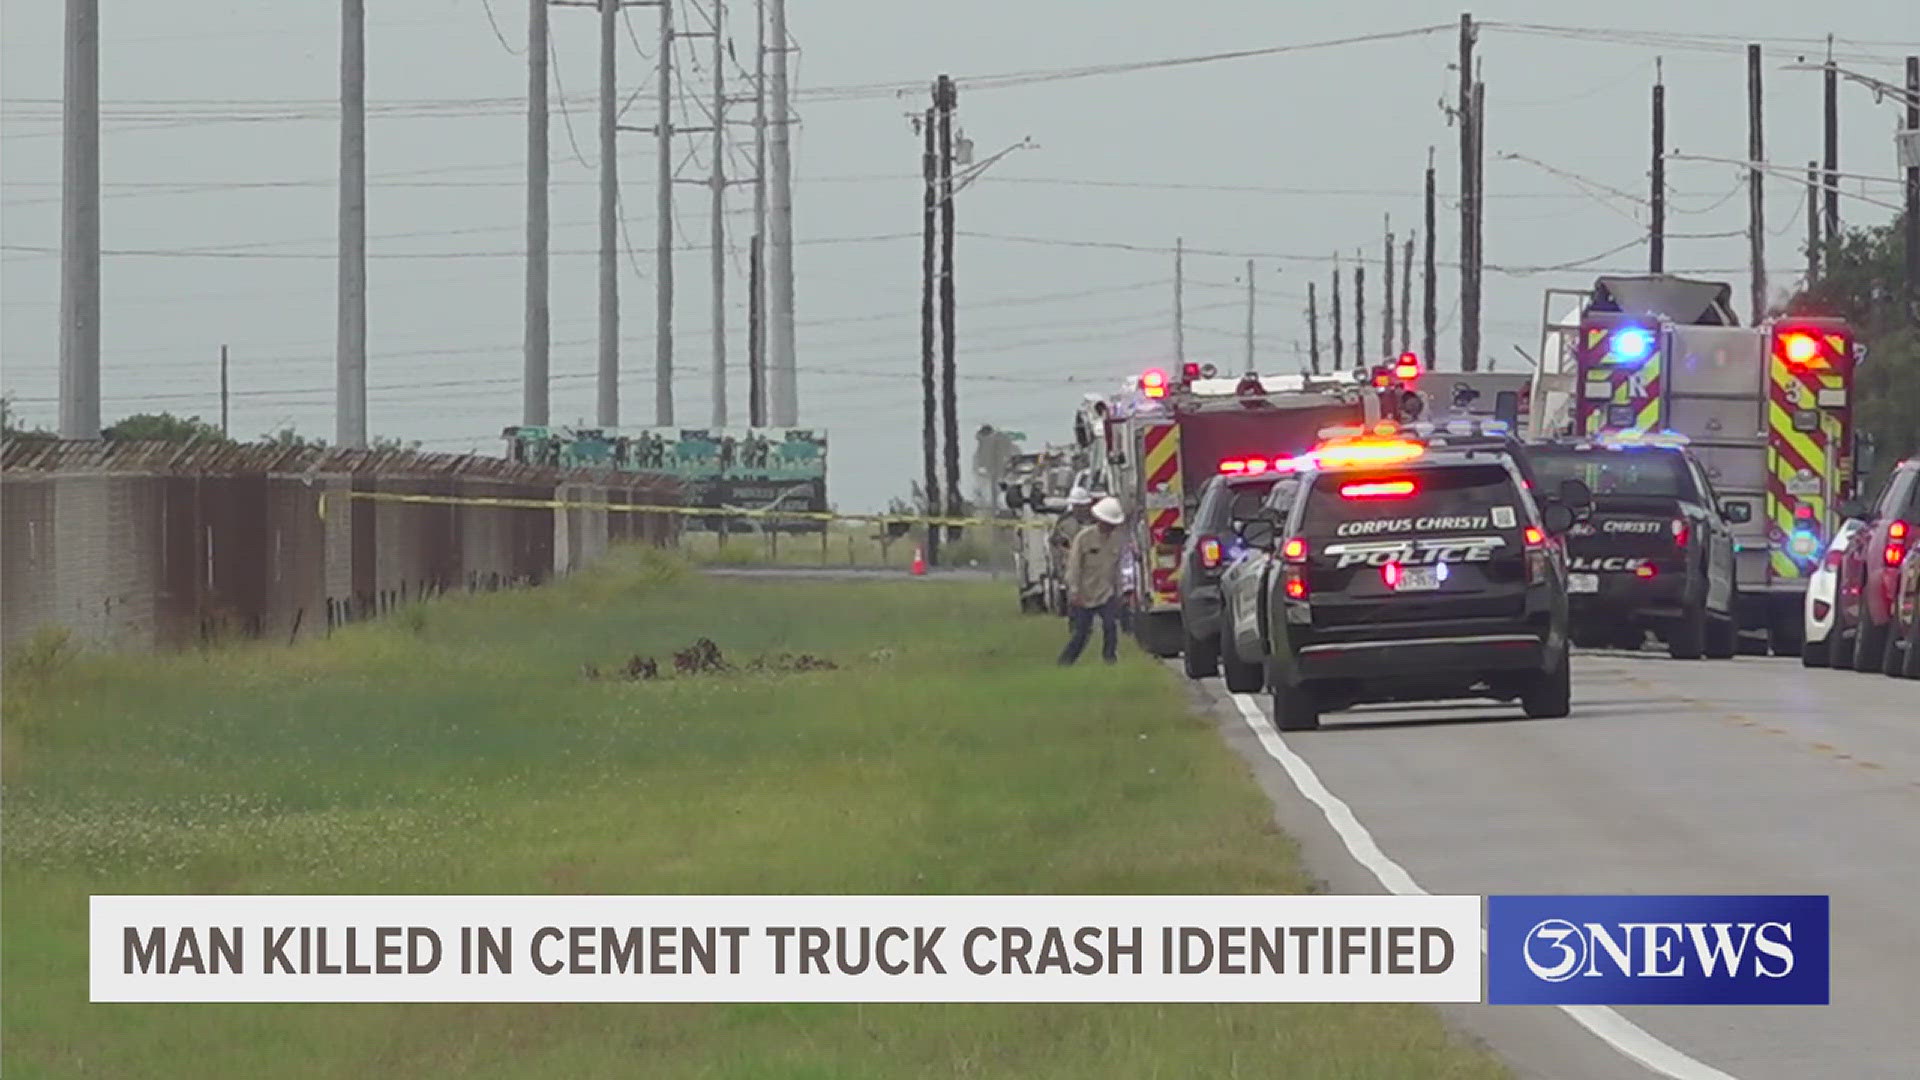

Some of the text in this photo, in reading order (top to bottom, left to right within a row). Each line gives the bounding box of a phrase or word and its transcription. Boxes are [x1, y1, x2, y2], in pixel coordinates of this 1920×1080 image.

[1628, 374, 1649, 398] R
[1337, 516, 1488, 536] CORPUS CHRISTI
[1336, 544, 1493, 568] POLICE
[1566, 557, 1650, 571] LICE
